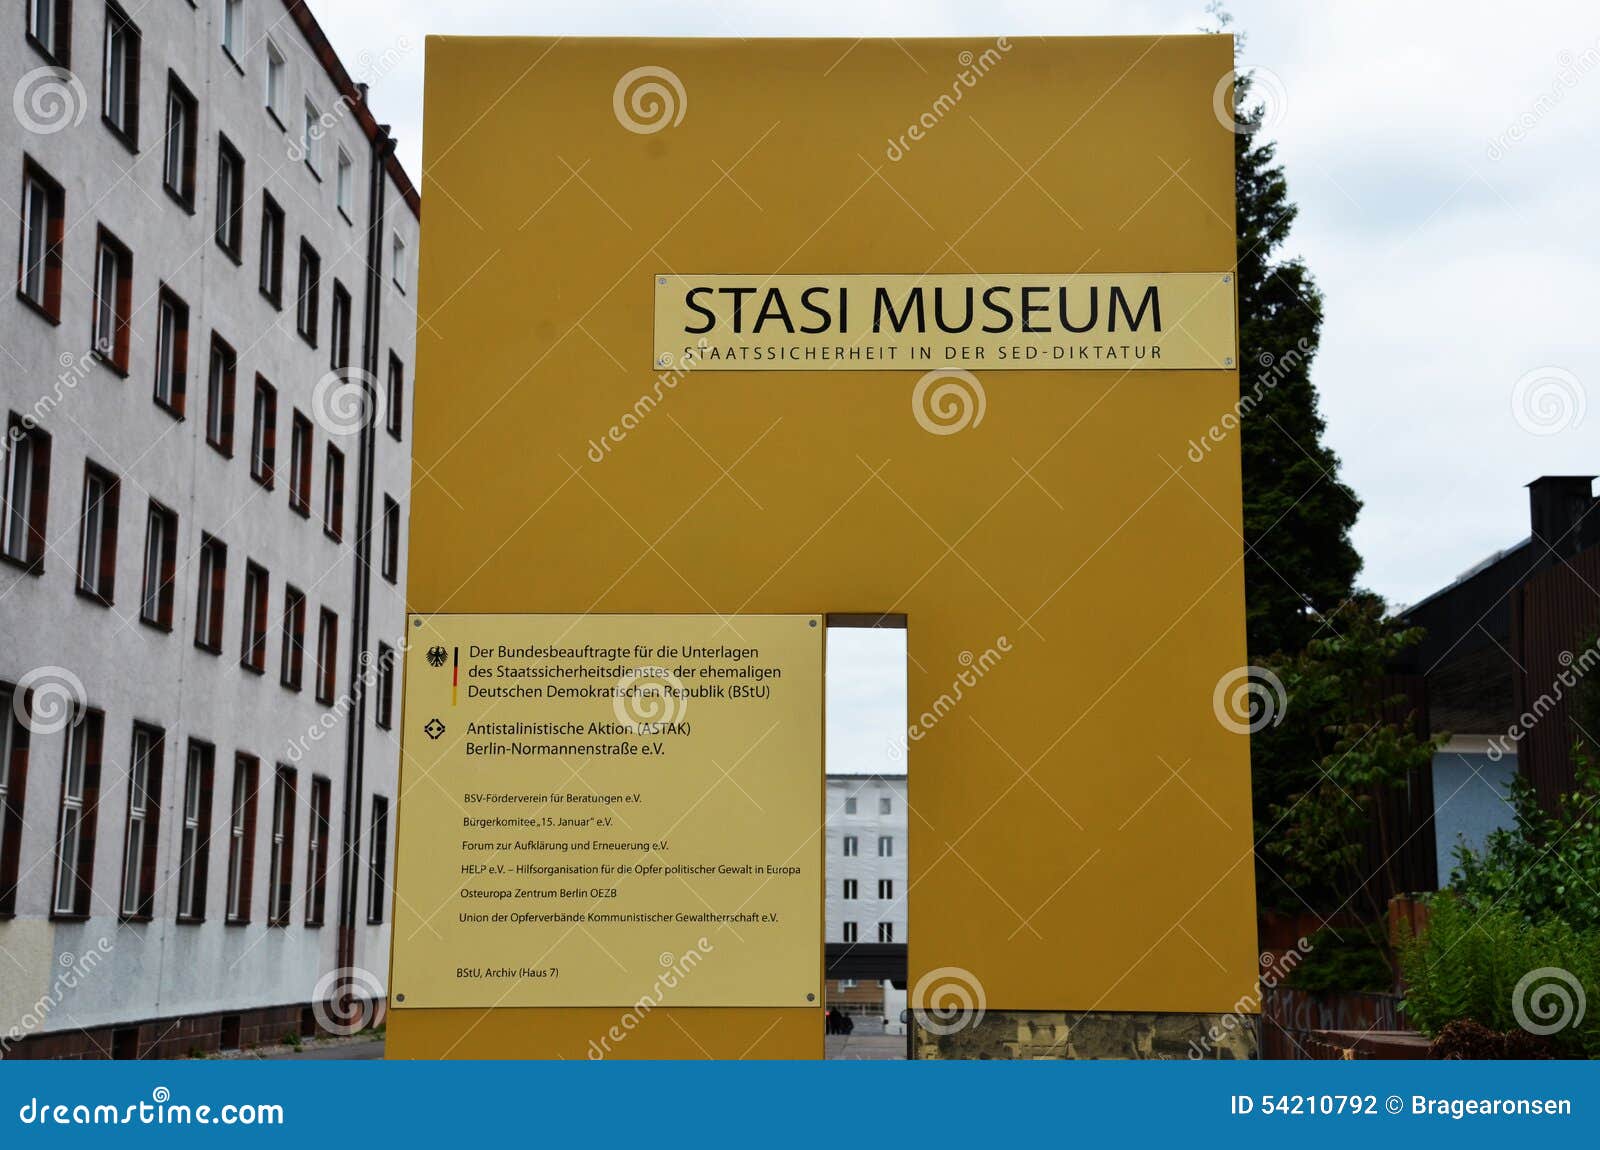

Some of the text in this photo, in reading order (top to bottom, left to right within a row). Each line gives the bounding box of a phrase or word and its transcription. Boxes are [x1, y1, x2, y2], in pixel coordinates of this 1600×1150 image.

[683, 285, 1162, 335] STASI MUSEUM
[684, 344, 1161, 361] STAATSSICHERHEIT IN DER SED-DIKTATUR
[469, 644, 759, 662] Der Bundesbeauftragte für die Unterlagen
[468, 664, 782, 682] des Staatssicherheitsdienstes der ehemaligen
[467, 684, 770, 701] Deutschen Demokratischen Republik (BStU)
[466, 720, 691, 737] Antistalinistische Aktion (ASTAK)
[465, 741, 665, 756] Berlin-Normannenstraße e.V.
[463, 792, 642, 806] BSV-Förderverein für Beratungen e.V.
[596, 816, 614, 827] e.V.
[461, 839, 669, 853] Forum zur Aufklärung und Erneuerung e.V.
[460, 864, 488, 875] HELP
[488, 864, 506, 875] e.V.
[515, 863, 599, 877] Hilfsorganisation
[600, 863, 615, 875] für
[616, 864, 633, 875] die
[634, 863, 663, 877] Opfer
[664, 864, 717, 877] politischer
[717, 864, 753, 875] Gewalt
[754, 864, 765, 875] in
[766, 864, 801, 877] Europa
[460, 887, 618, 901] Osteuropa Zentrum Berlin OEZB
[459, 911, 779, 925] Union der Opferverbände Kommunistischer Gewaltherrschaft e.V.
[456, 967, 559, 979] BStU, Archiv (Haus 7)
